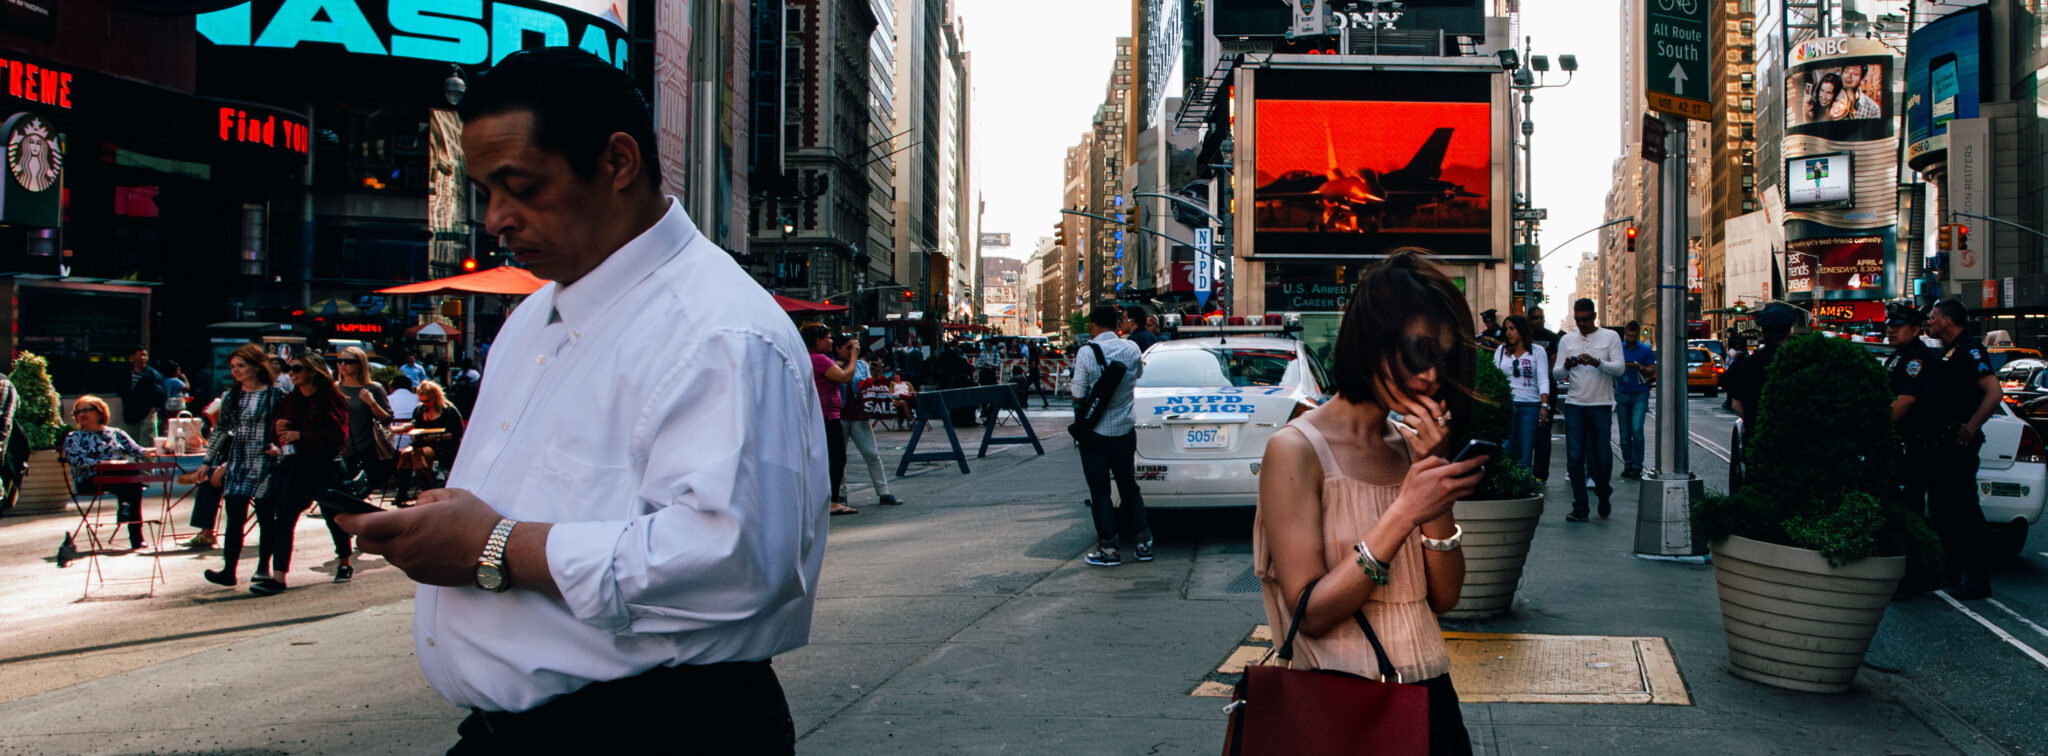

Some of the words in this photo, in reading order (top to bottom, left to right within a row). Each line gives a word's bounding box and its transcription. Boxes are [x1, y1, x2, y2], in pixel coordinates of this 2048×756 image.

[1332, 11, 1404, 31] ONY
[1653, 23, 1669, 37] Alt
[1672, 26, 1702, 42] Route
[1657, 40, 1699, 61] South
[1814, 39, 1848, 56] NBC
[1678, 102, 1689, 113] 42
[1692, 104, 1702, 115] ST
[220, 107, 275, 148] Find
[1964, 144, 1973, 190] REUTERS
[1198, 231, 1207, 290] NYPD
[1283, 283, 1308, 294] U.S.
[1848, 274, 1860, 288] 4
[864, 400, 897, 414] SALE
[1166, 395, 1243, 405] NYPD
[1153, 405, 1256, 416] POLICE
[1187, 430, 1218, 443] 5057
